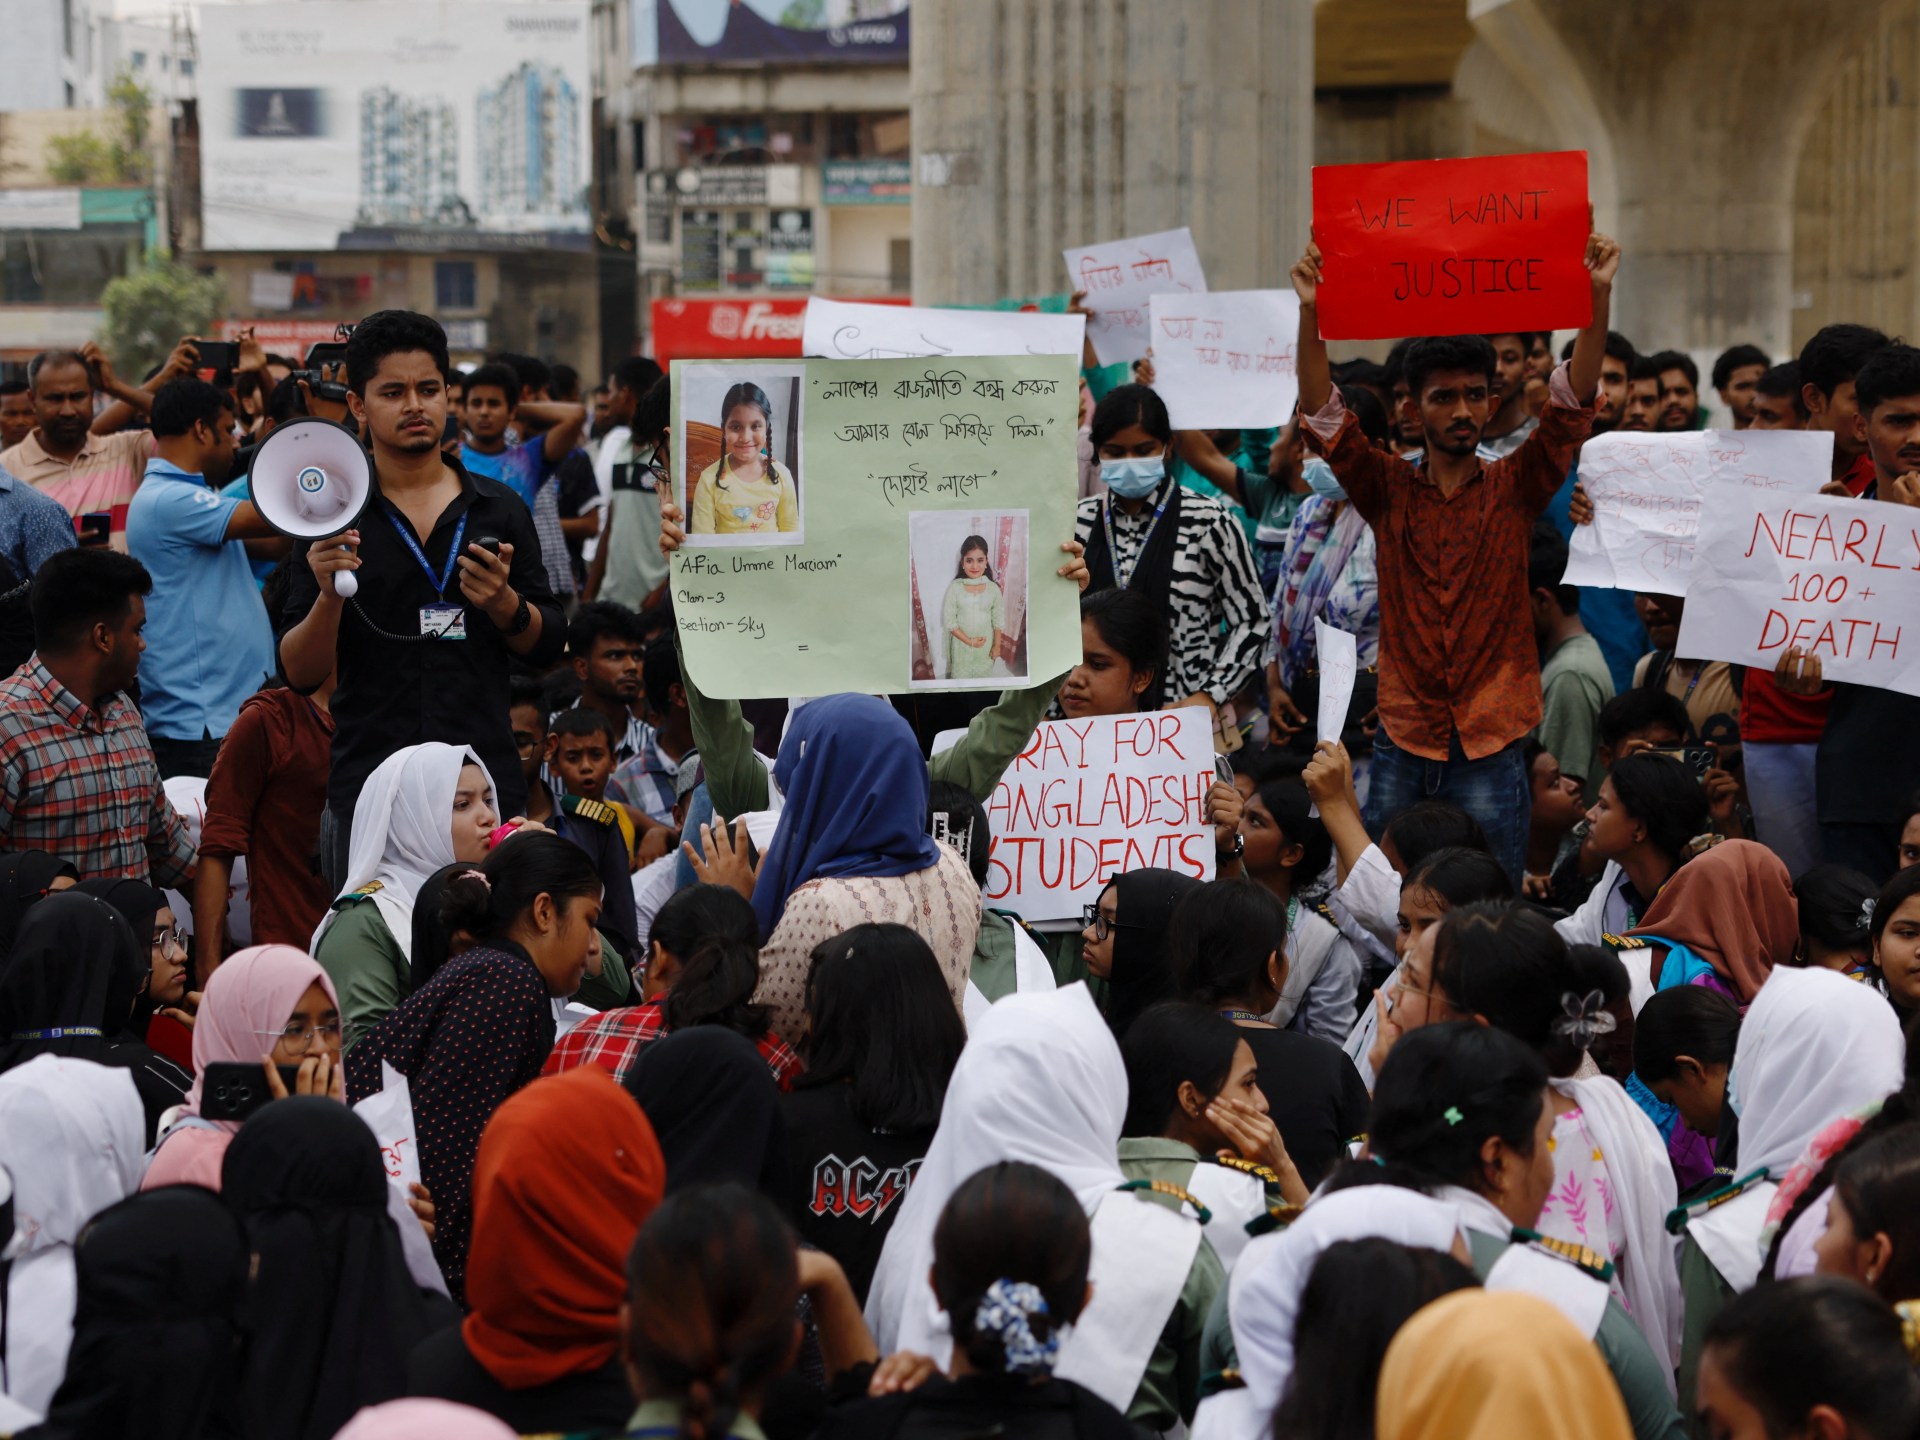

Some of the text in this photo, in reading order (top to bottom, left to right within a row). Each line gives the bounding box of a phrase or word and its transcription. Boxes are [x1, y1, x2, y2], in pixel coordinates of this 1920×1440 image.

[1355, 190, 1549, 229] WE WANT
[1392, 258, 1545, 301] JUSTICE
[893, 370, 967, 401] রাজনীতি
[972, 379, 1006, 401] বন্ধ
[1011, 380, 1059, 397] করুন
[834, 424, 890, 443] আমার
[902, 423, 935, 447] বোন
[733, 556, 774, 573] Umme
[1781, 573, 1848, 603] 100
[679, 616, 765, 640] Section-Sky
[1758, 608, 1901, 661] DEATH
[1015, 714, 1186, 772] RAY FOR
[988, 770, 1214, 833] ANGLADESHI
[987, 833, 1205, 899] STUDENTS
